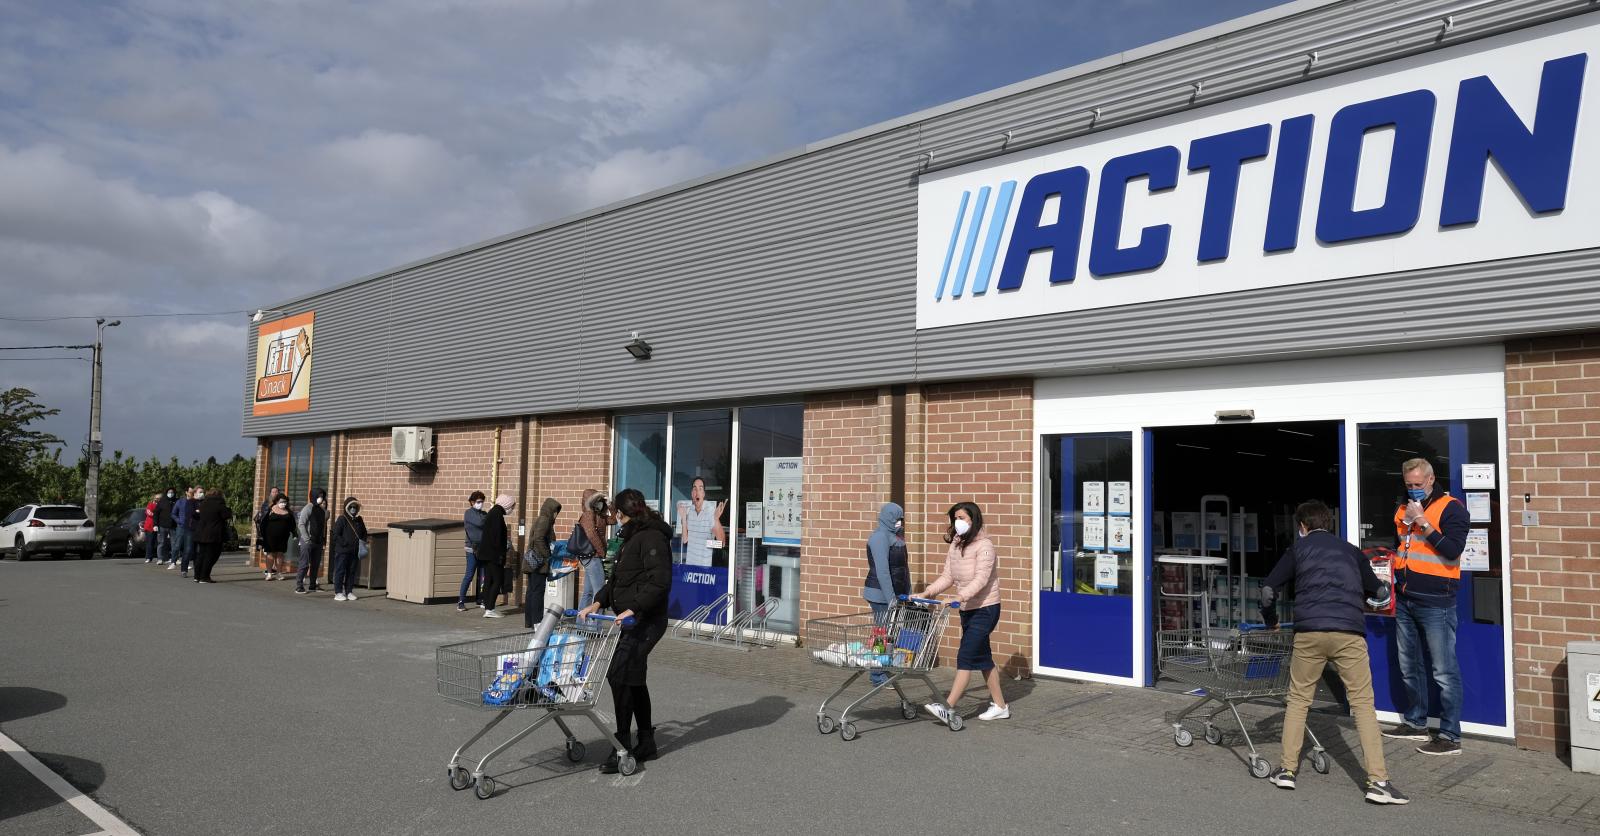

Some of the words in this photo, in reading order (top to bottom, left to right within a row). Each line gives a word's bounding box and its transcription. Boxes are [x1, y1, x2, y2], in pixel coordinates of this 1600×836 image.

[997, 52, 1588, 291] ACTION
[261, 376, 286, 397] Snack
[778, 462, 799, 470] ACTION
[686, 572, 716, 586] ACTION
